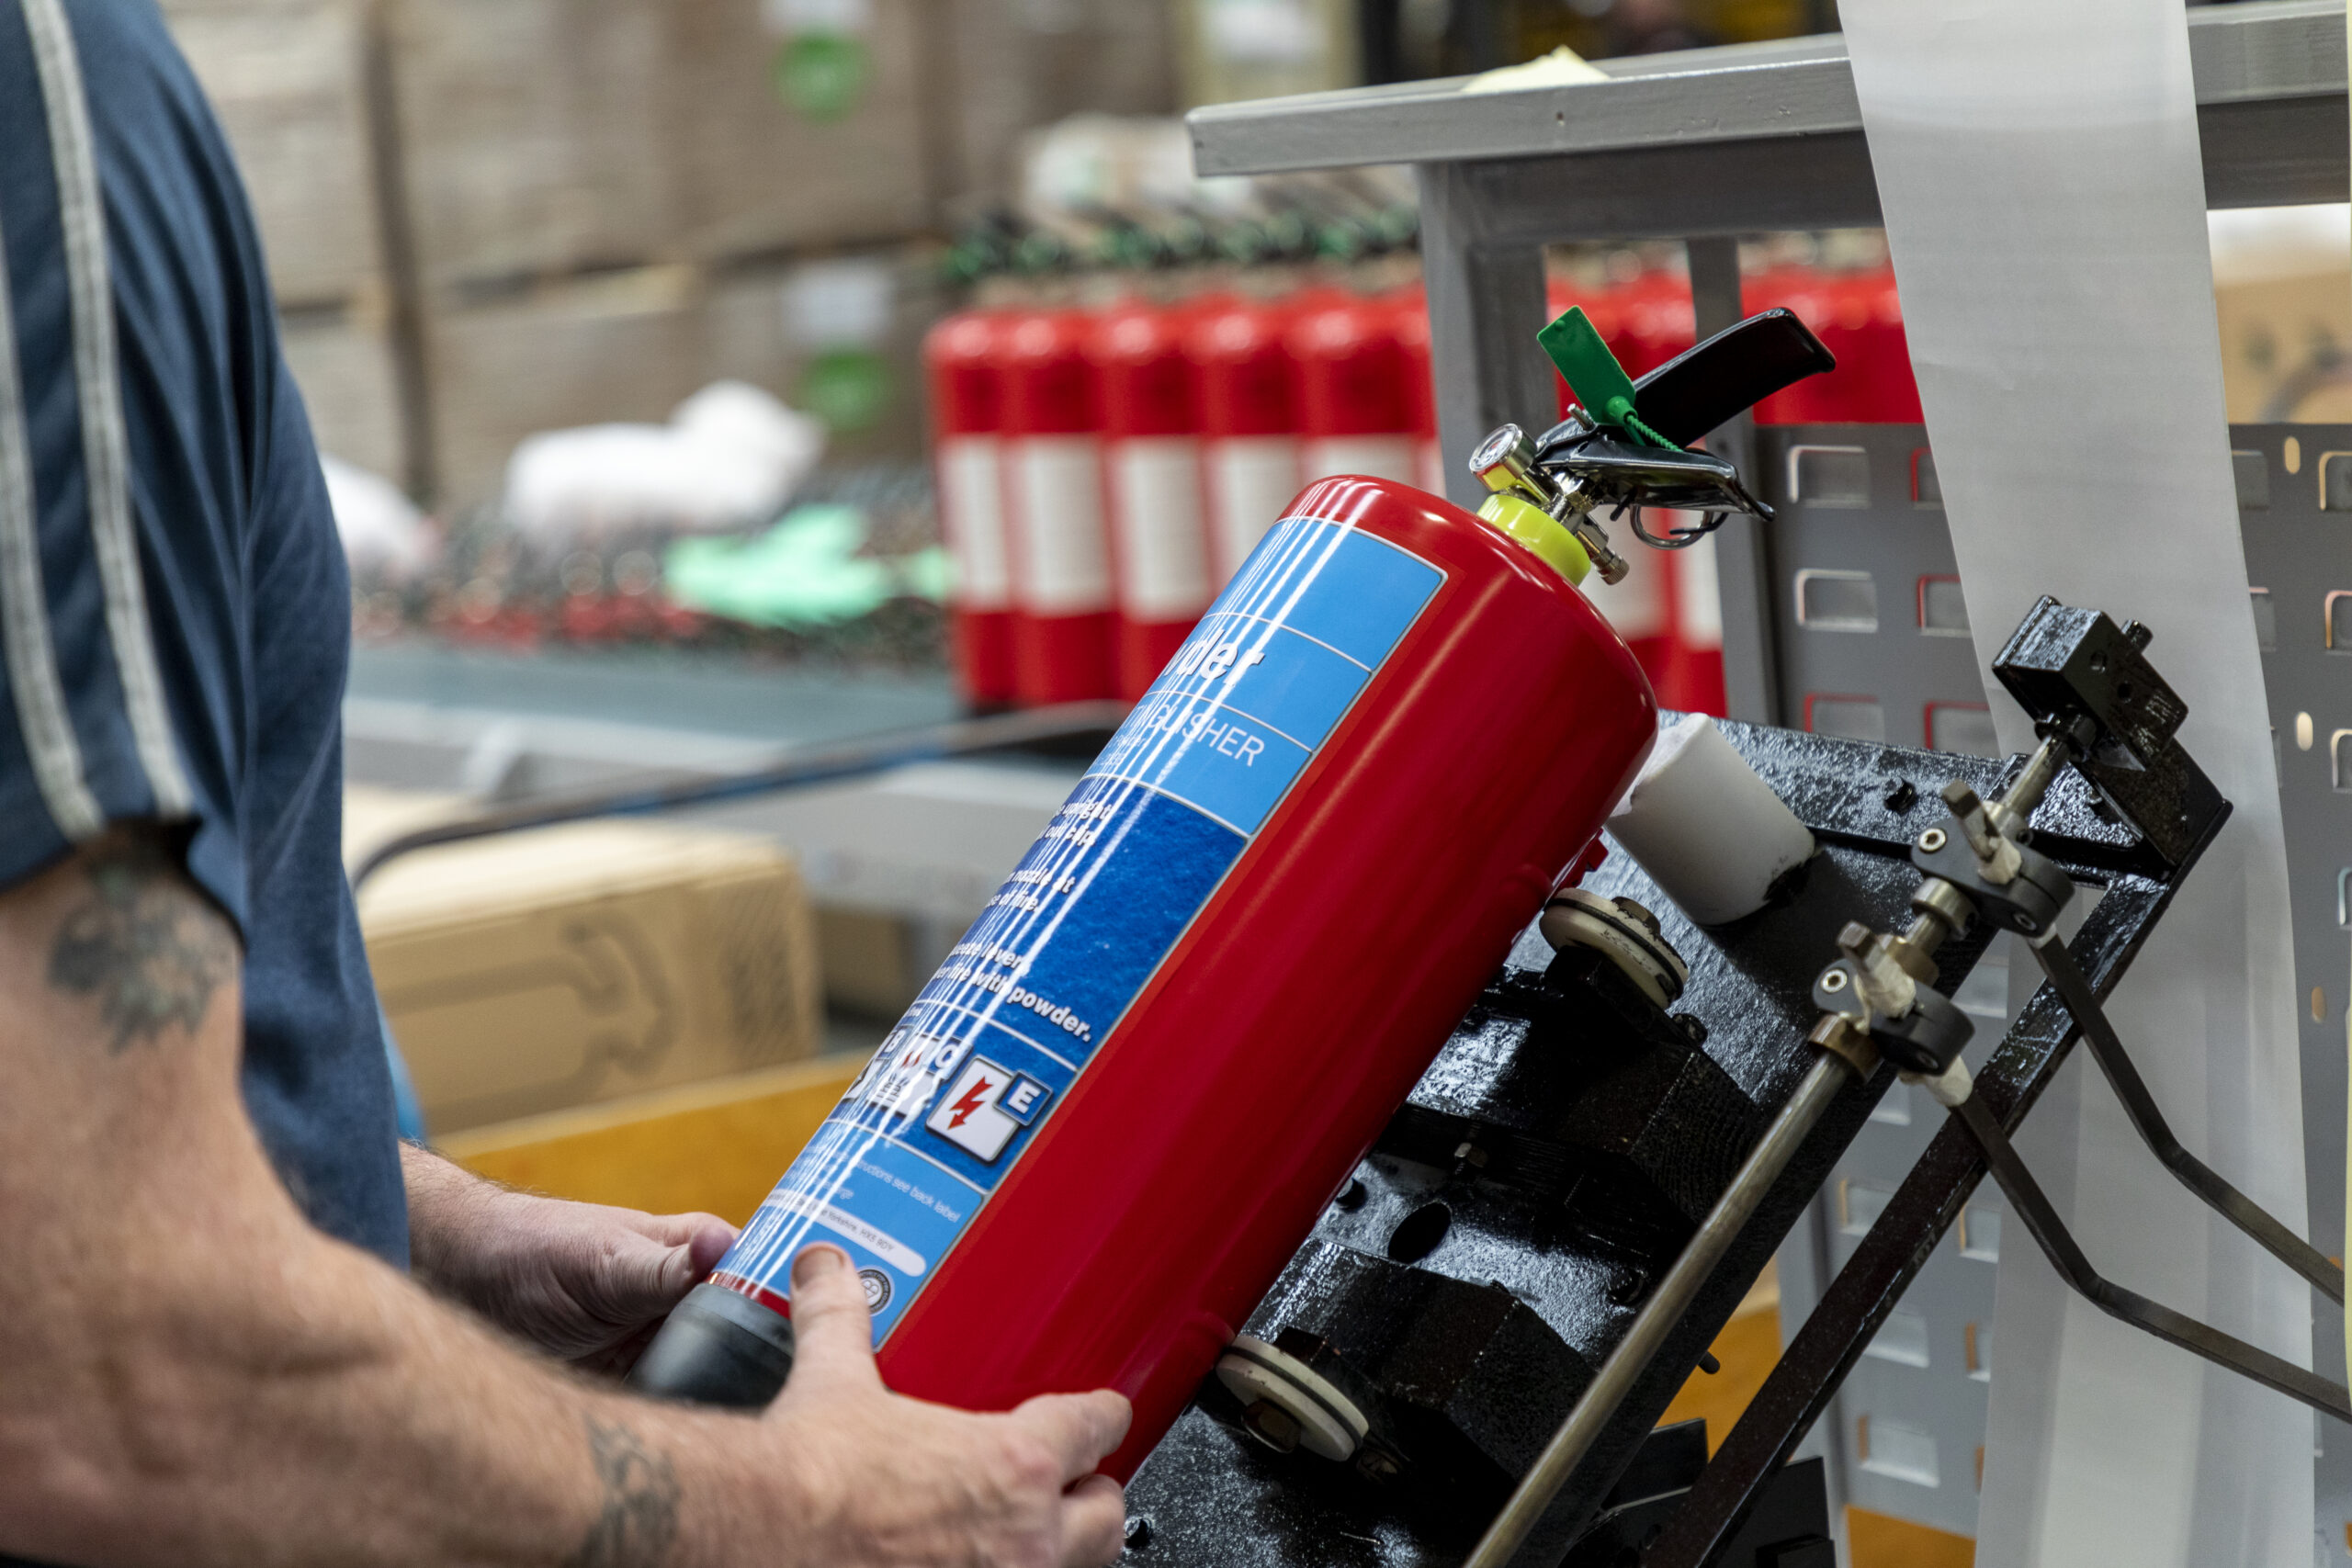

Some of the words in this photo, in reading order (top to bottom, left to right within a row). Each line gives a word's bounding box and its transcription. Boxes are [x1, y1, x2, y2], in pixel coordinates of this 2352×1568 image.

[972, 970, 1012, 995] with
[1006, 986, 1091, 1043] powder.
[1007, 1080, 1041, 1115] E
[891, 1177, 911, 1193] see
[910, 1186, 934, 1208] back
[933, 1201, 962, 1224] label
